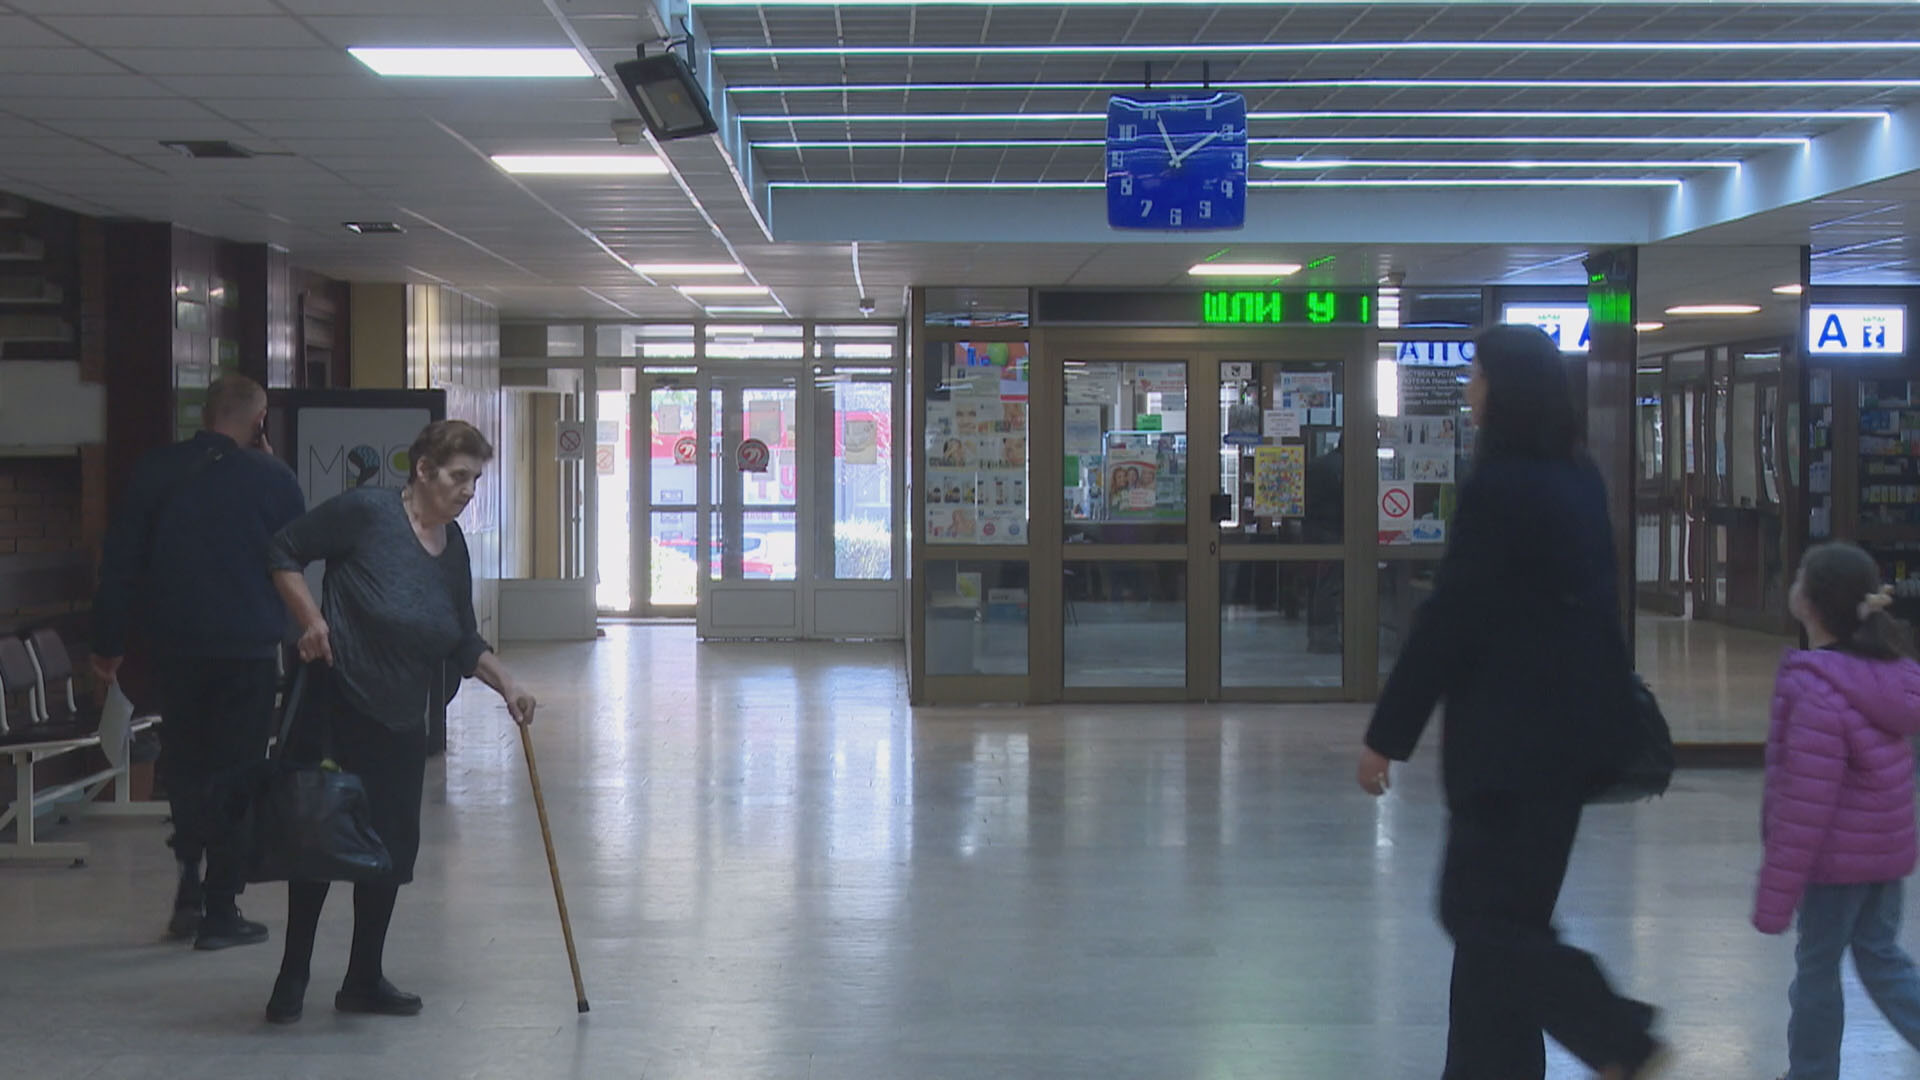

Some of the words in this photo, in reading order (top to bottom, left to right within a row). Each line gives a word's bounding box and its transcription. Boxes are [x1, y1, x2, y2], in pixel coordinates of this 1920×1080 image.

[1118, 123, 1138, 142] 10
[1221, 123, 1235, 142] 2
[1111, 150, 1124, 168] 9
[1231, 151, 1244, 170] 3
[1120, 177, 1133, 196] 8
[1220, 179, 1234, 199] 4
[1140, 199, 1153, 218] 7
[1169, 207, 1182, 226] 6
[1199, 200, 1212, 219] 5
